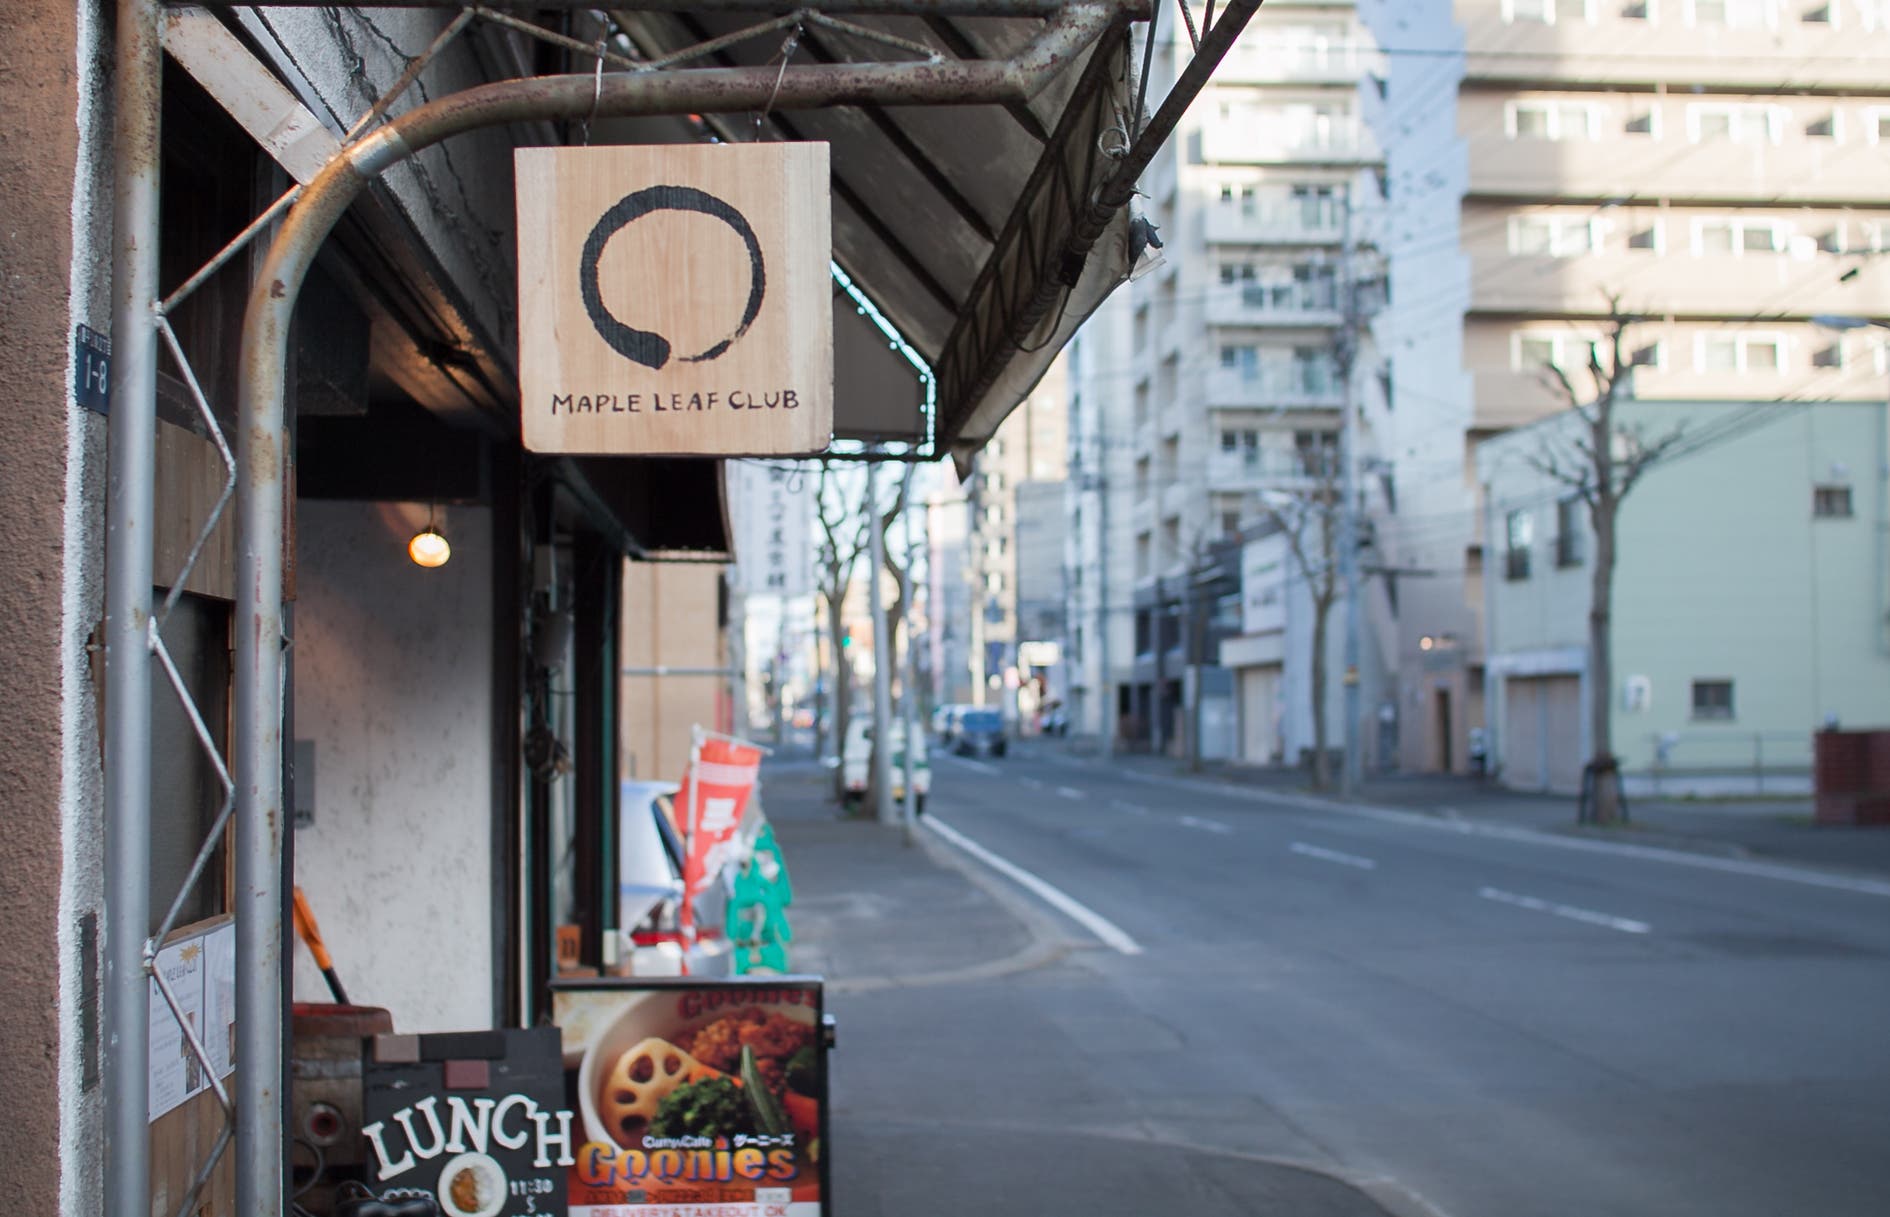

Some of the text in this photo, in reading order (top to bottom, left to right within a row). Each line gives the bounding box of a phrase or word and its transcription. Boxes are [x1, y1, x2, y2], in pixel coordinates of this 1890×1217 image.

[85, 353, 108, 395] 1-8
[552, 390, 800, 415] MAPLE LEAF CLUB
[362, 1094, 576, 1182] LUNCH
[577, 1135, 798, 1187] Goonies
[509, 1178, 554, 1196] 11:30
